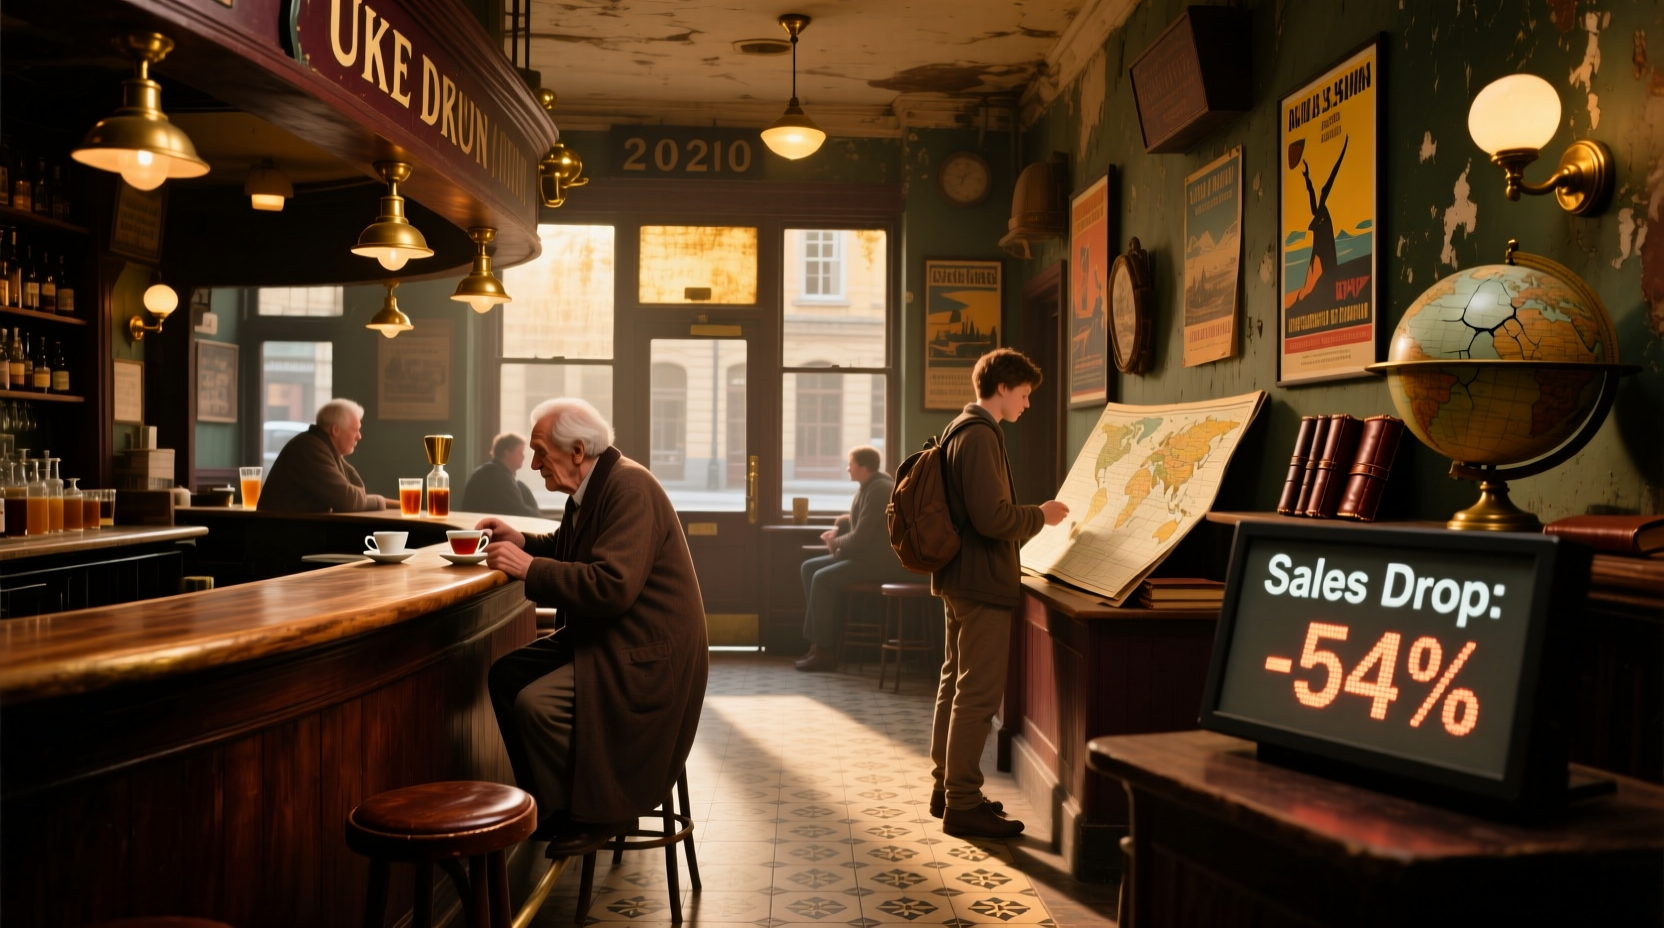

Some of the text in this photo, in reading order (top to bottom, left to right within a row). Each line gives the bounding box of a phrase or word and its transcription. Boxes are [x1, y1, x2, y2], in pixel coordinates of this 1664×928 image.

[623, 138, 751, 172] 20210
[1264, 553, 1505, 628] Sales Drop:
[1265, 621, 1479, 736] -54%
